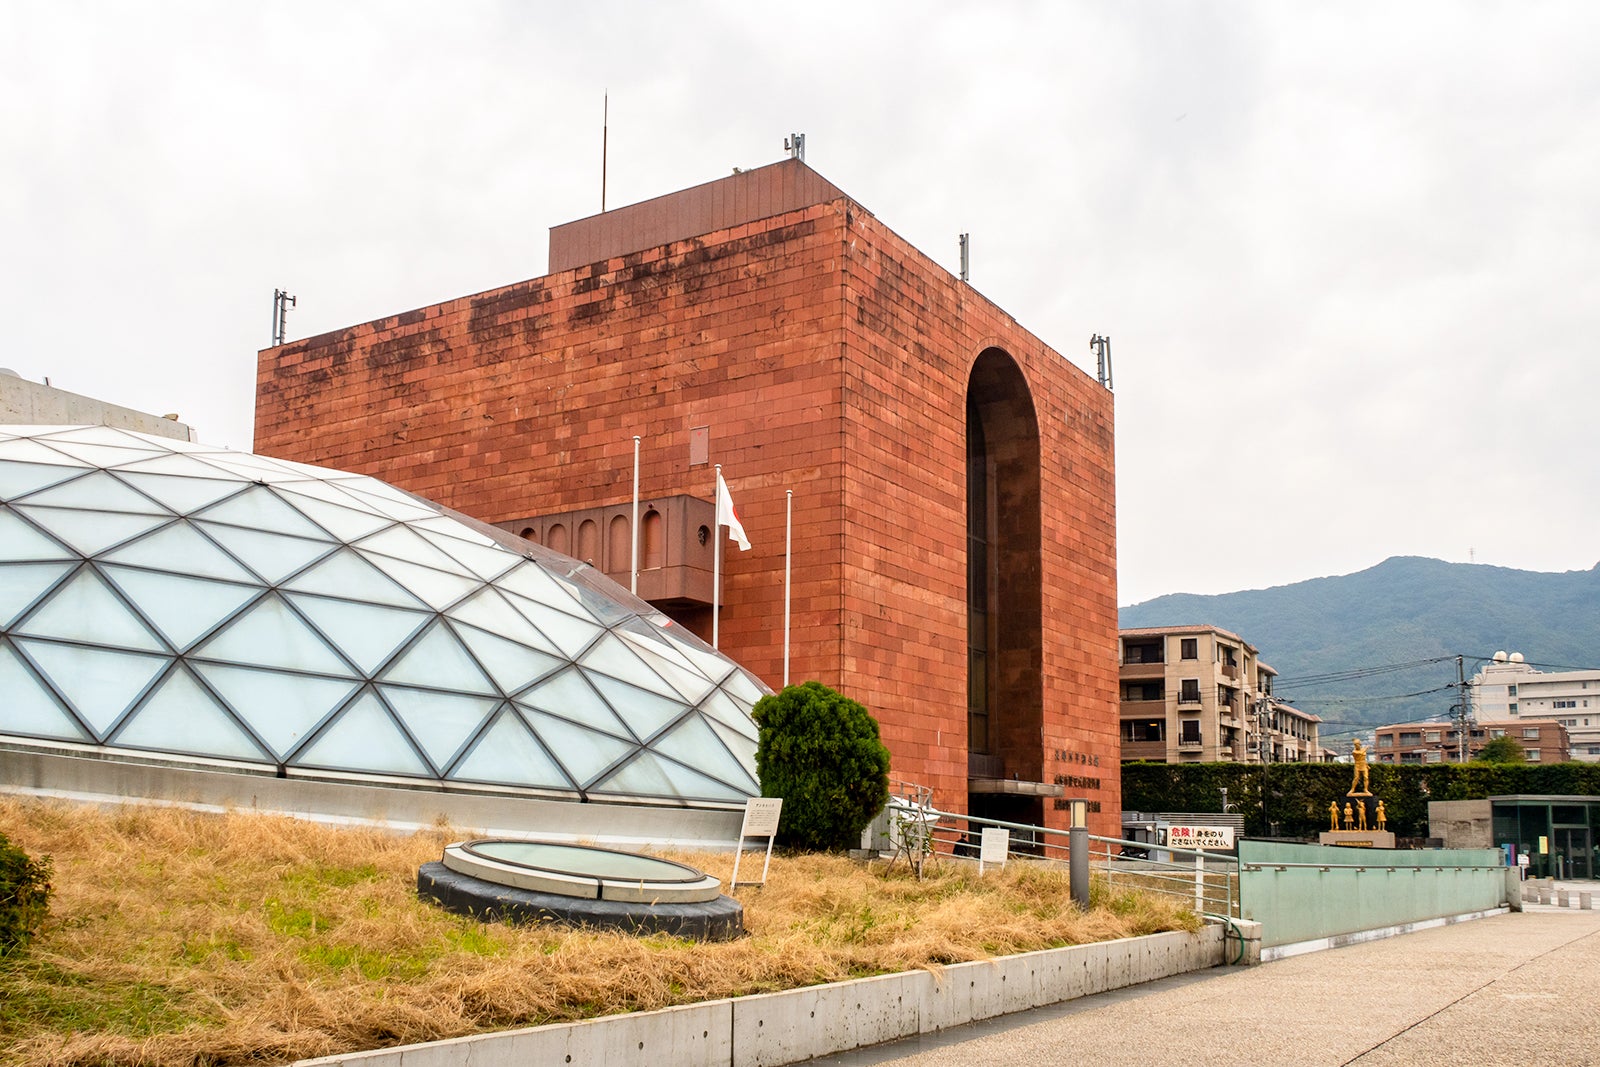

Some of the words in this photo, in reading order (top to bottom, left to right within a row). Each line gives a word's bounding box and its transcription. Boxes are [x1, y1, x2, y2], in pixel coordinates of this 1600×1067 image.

[1171, 827, 1195, 838] 危険！
[1197, 830, 1224, 838] 身をのり
